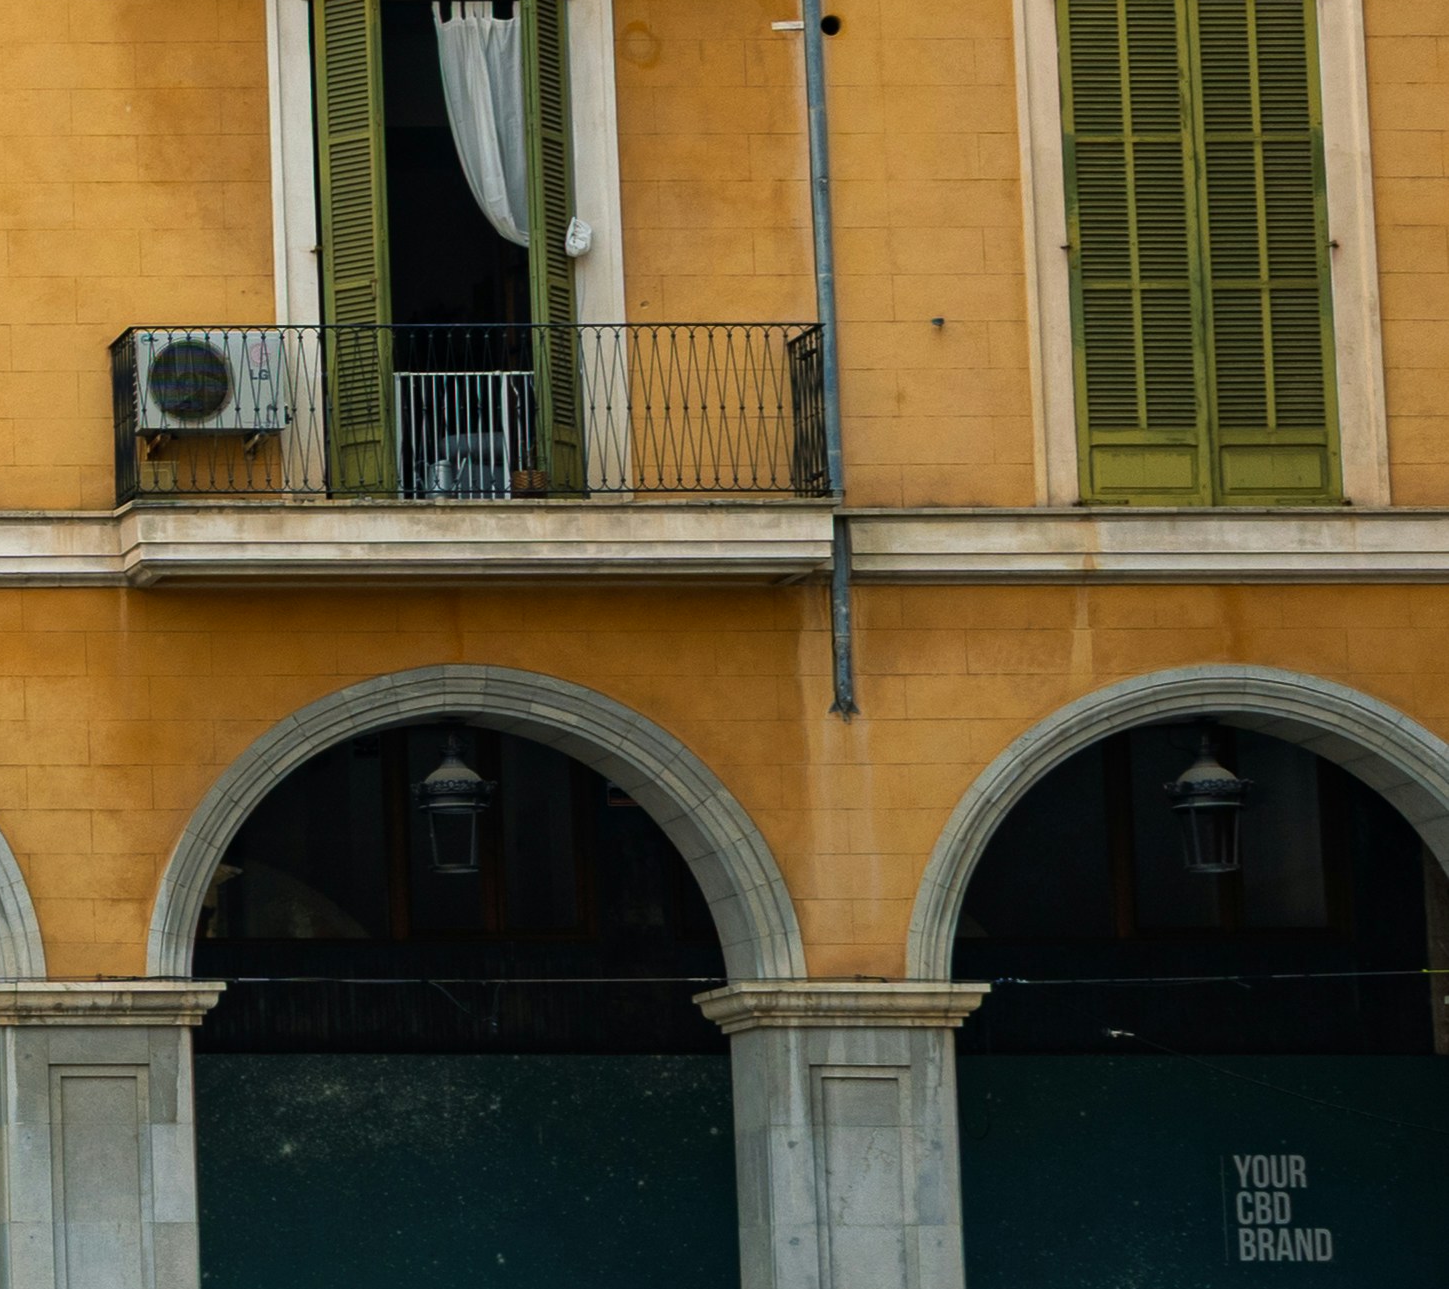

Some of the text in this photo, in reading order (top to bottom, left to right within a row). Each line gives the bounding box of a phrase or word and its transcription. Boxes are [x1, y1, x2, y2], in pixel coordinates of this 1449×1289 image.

[1232, 1154, 1308, 1189] YOUR
[1235, 1190, 1292, 1226] CBD
[1237, 1227, 1333, 1263] BRAND
